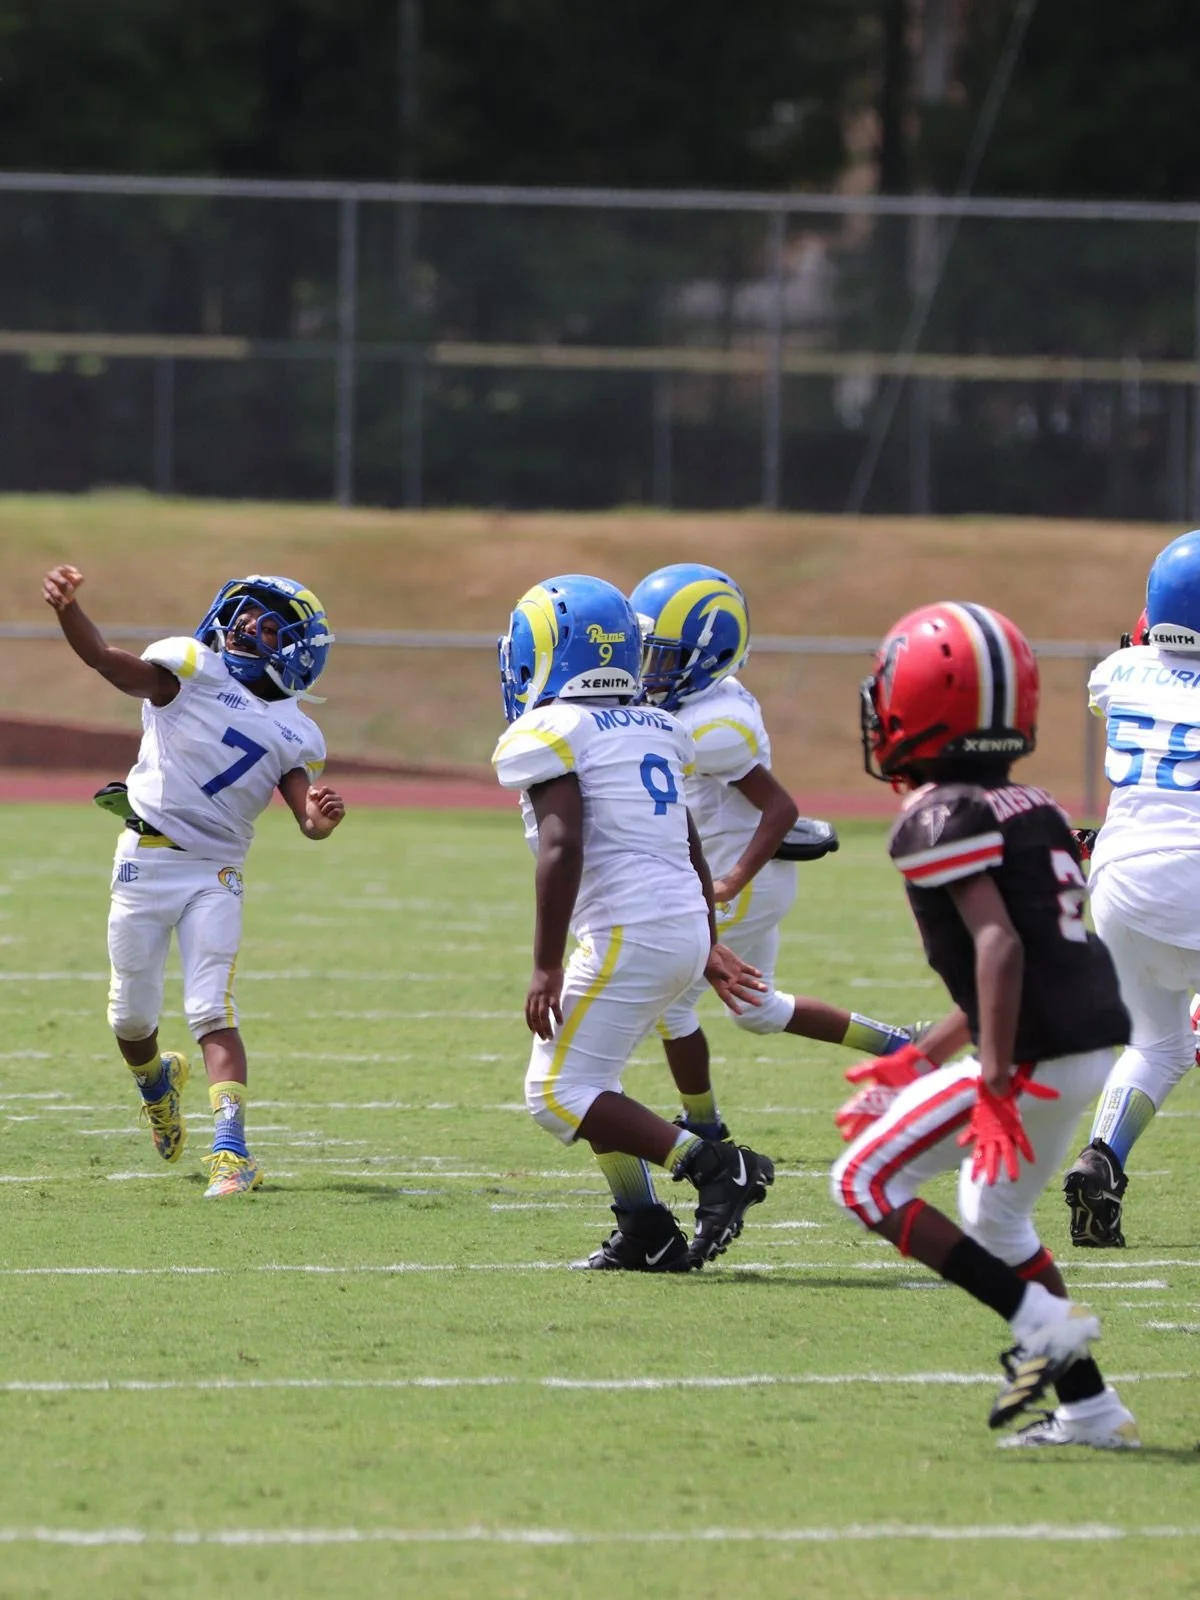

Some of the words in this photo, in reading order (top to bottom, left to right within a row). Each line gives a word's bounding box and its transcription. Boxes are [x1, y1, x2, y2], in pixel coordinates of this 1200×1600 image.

[586, 624, 625, 643] Rams
[1153, 633, 1195, 645] XENITH
[599, 643, 613, 666] 9
[581, 677, 629, 689] XENITH
[1109, 664, 1136, 683] M
[590, 708, 673, 732] MOORE
[963, 738, 1024, 752] XENITH
[1104, 706, 1200, 792] 58
[200, 726, 268, 798] 7
[640, 752, 678, 816] 9
